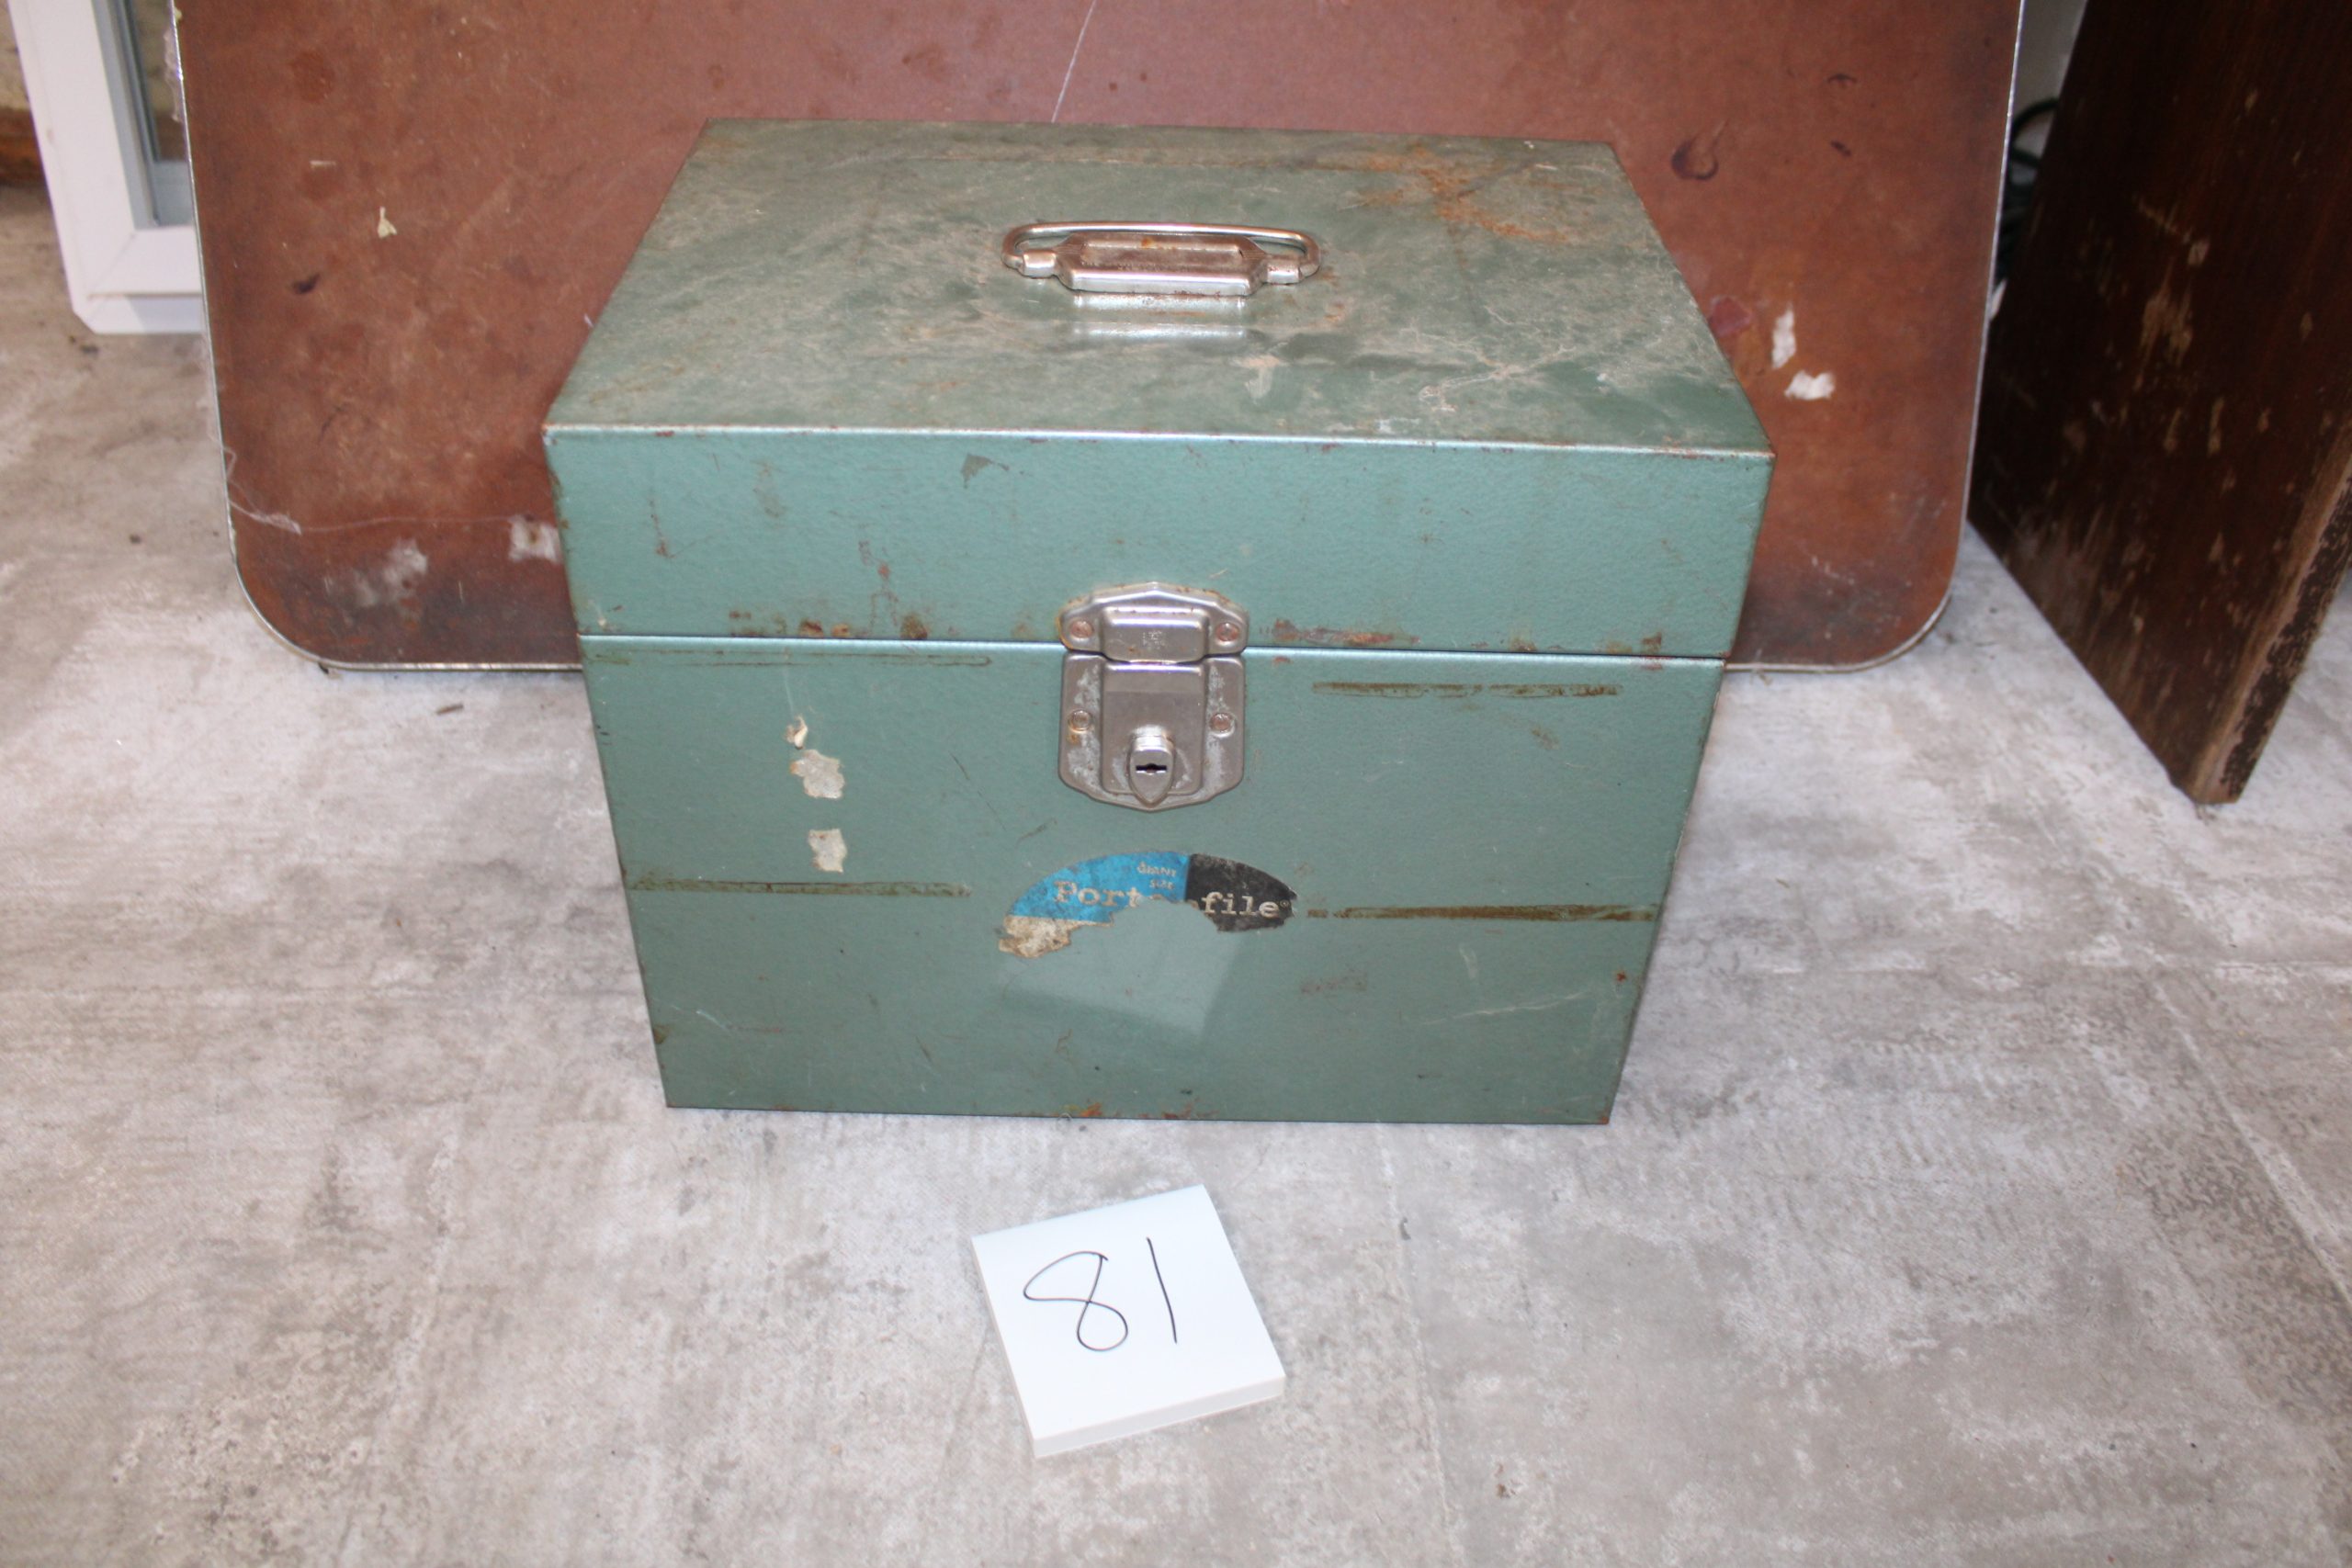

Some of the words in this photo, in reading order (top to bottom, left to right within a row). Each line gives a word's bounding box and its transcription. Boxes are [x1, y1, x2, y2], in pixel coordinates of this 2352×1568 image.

[1054, 880, 1162, 908] Port
[1189, 890, 1280, 919] file
[1023, 1237, 1178, 1352] 81
